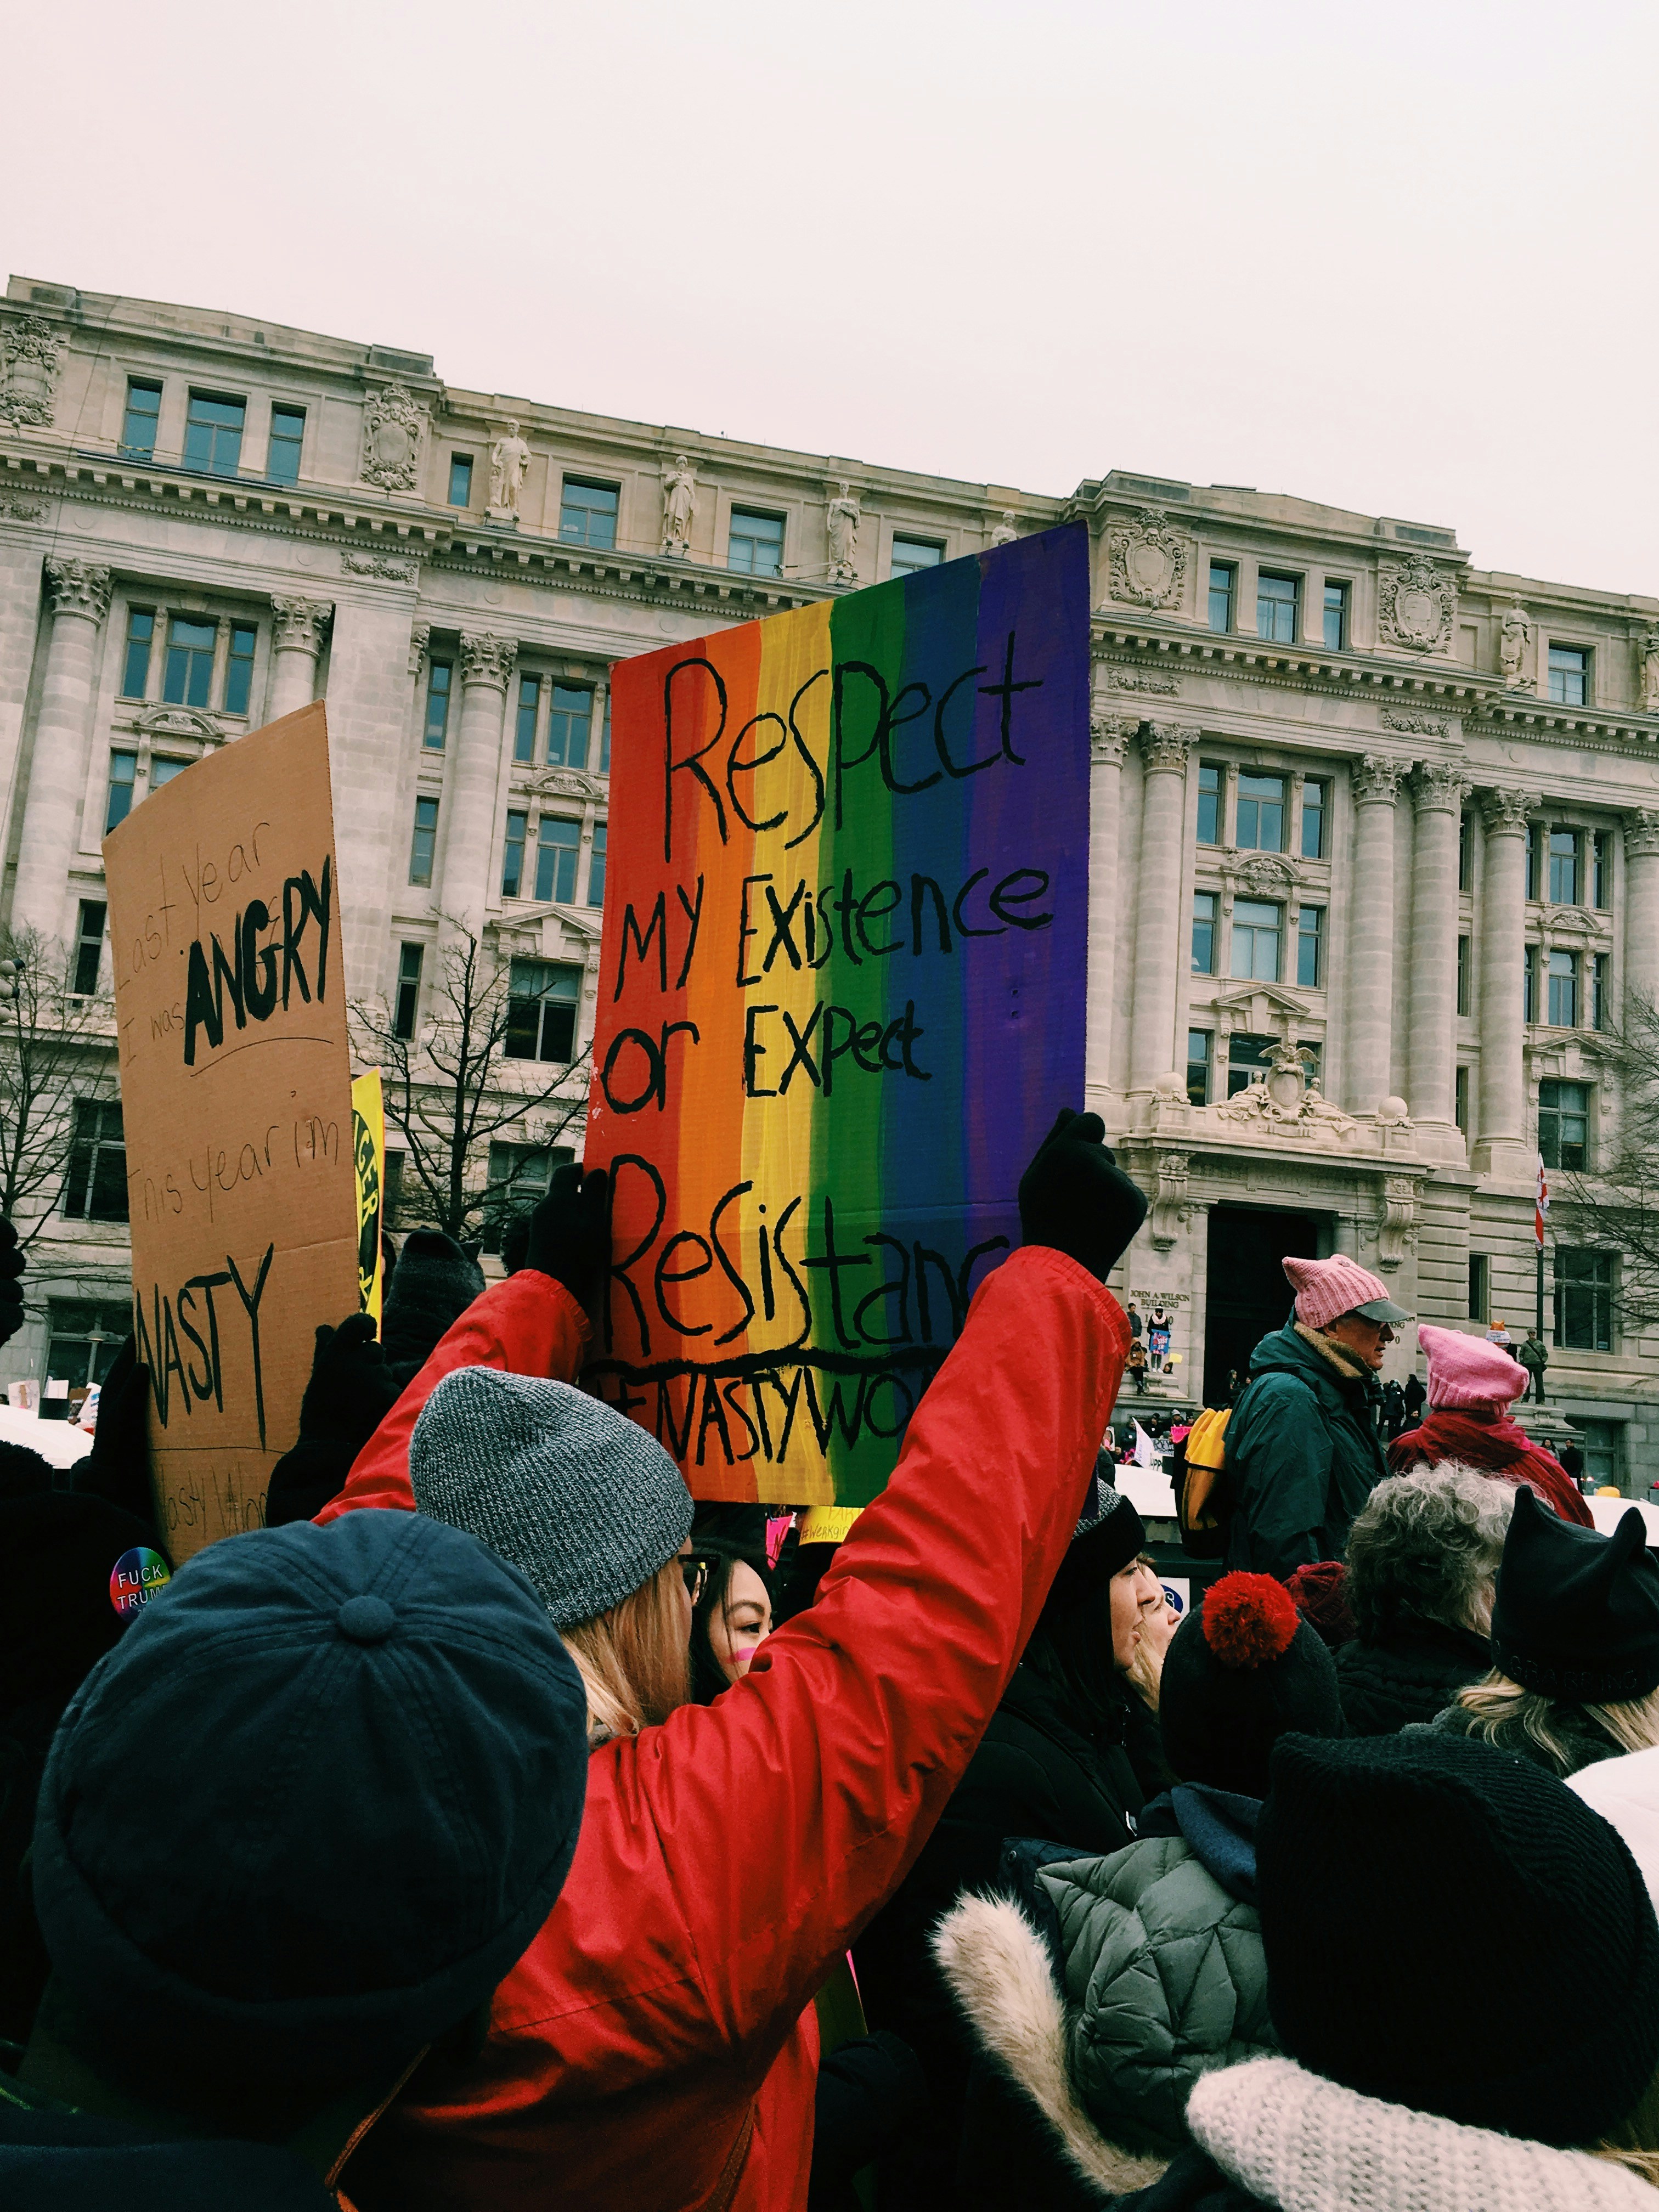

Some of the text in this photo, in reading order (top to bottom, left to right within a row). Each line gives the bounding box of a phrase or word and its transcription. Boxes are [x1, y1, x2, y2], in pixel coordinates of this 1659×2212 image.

[122, 853, 331, 1067] I was ANGRY
[605, 1154, 1011, 1357] Resistanc
[1130, 1290, 1151, 1298] JOHN
[1160, 1293, 1190, 1301] WILSON
[1141, 1299, 1179, 1308] BUILDING
[136, 1243, 274, 1451] NASTY
[117, 1564, 162, 1588] FUCK
[117, 1585, 165, 1610] TRUM
